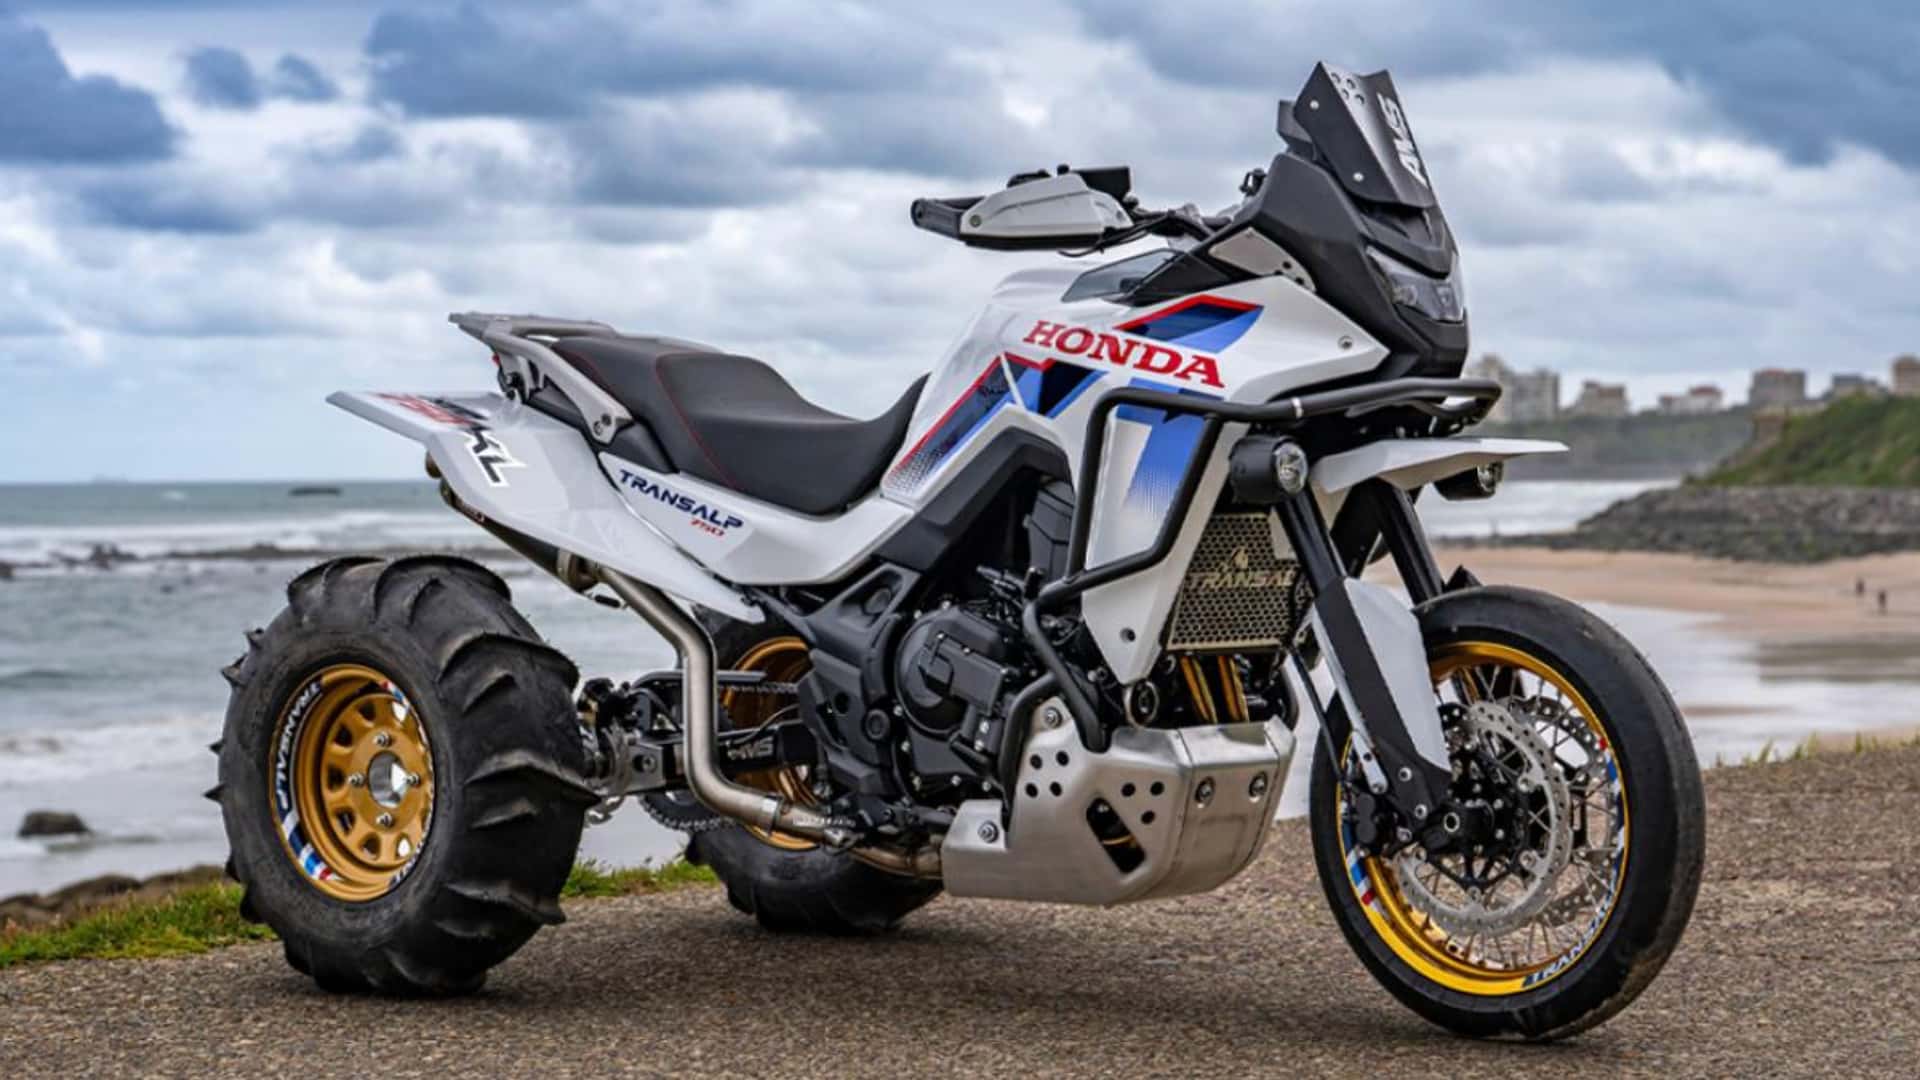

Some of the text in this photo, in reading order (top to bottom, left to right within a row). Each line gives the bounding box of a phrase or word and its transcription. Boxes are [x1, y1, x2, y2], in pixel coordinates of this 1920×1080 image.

[1022, 319, 1227, 389] HONDA
[619, 468, 744, 530] TRANSALP
[690, 517, 725, 537] 750
